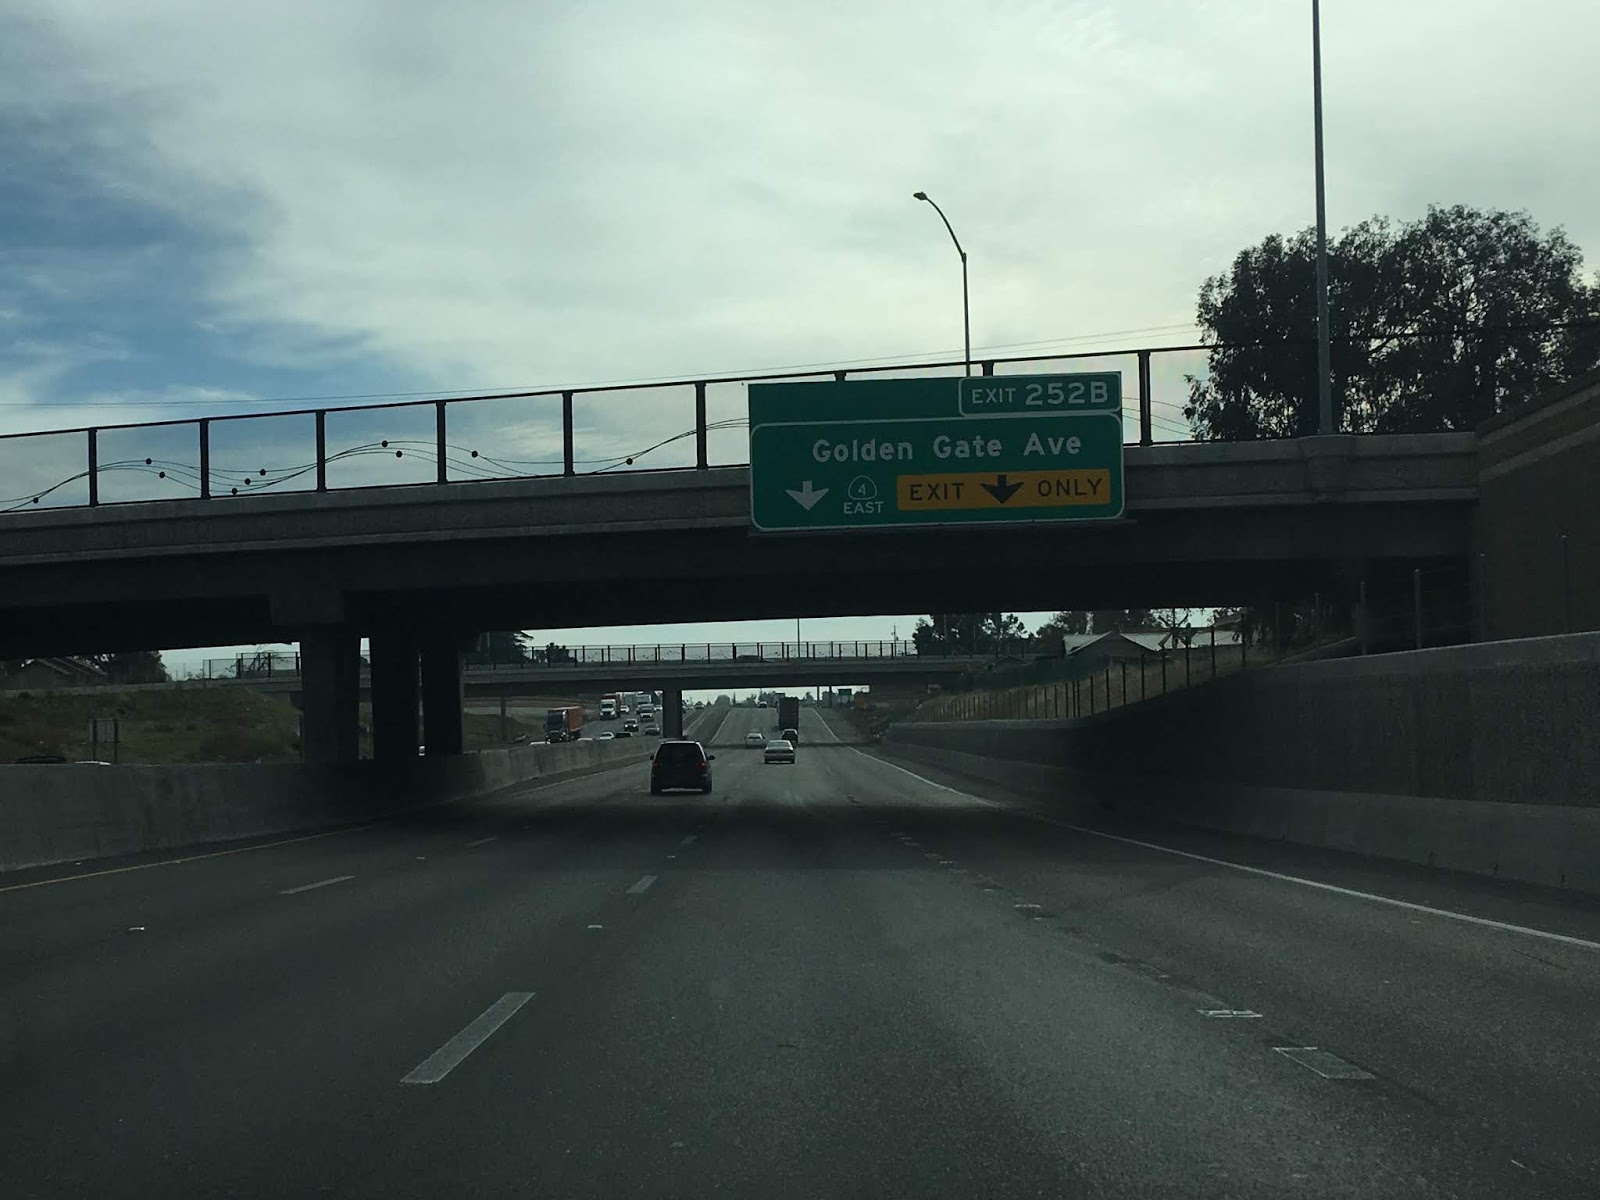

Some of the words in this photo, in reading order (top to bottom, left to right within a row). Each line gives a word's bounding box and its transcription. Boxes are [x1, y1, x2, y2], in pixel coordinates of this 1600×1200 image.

[971, 387, 1016, 404] EXIT
[1025, 381, 1109, 406] 252B
[812, 438, 913, 463] Golden
[932, 435, 1002, 459] Gate
[1023, 433, 1081, 456] Ave
[857, 483, 867, 496] 4
[909, 482, 965, 501] EXIT
[1037, 477, 1103, 497] ONLY
[843, 501, 884, 515] EAST
